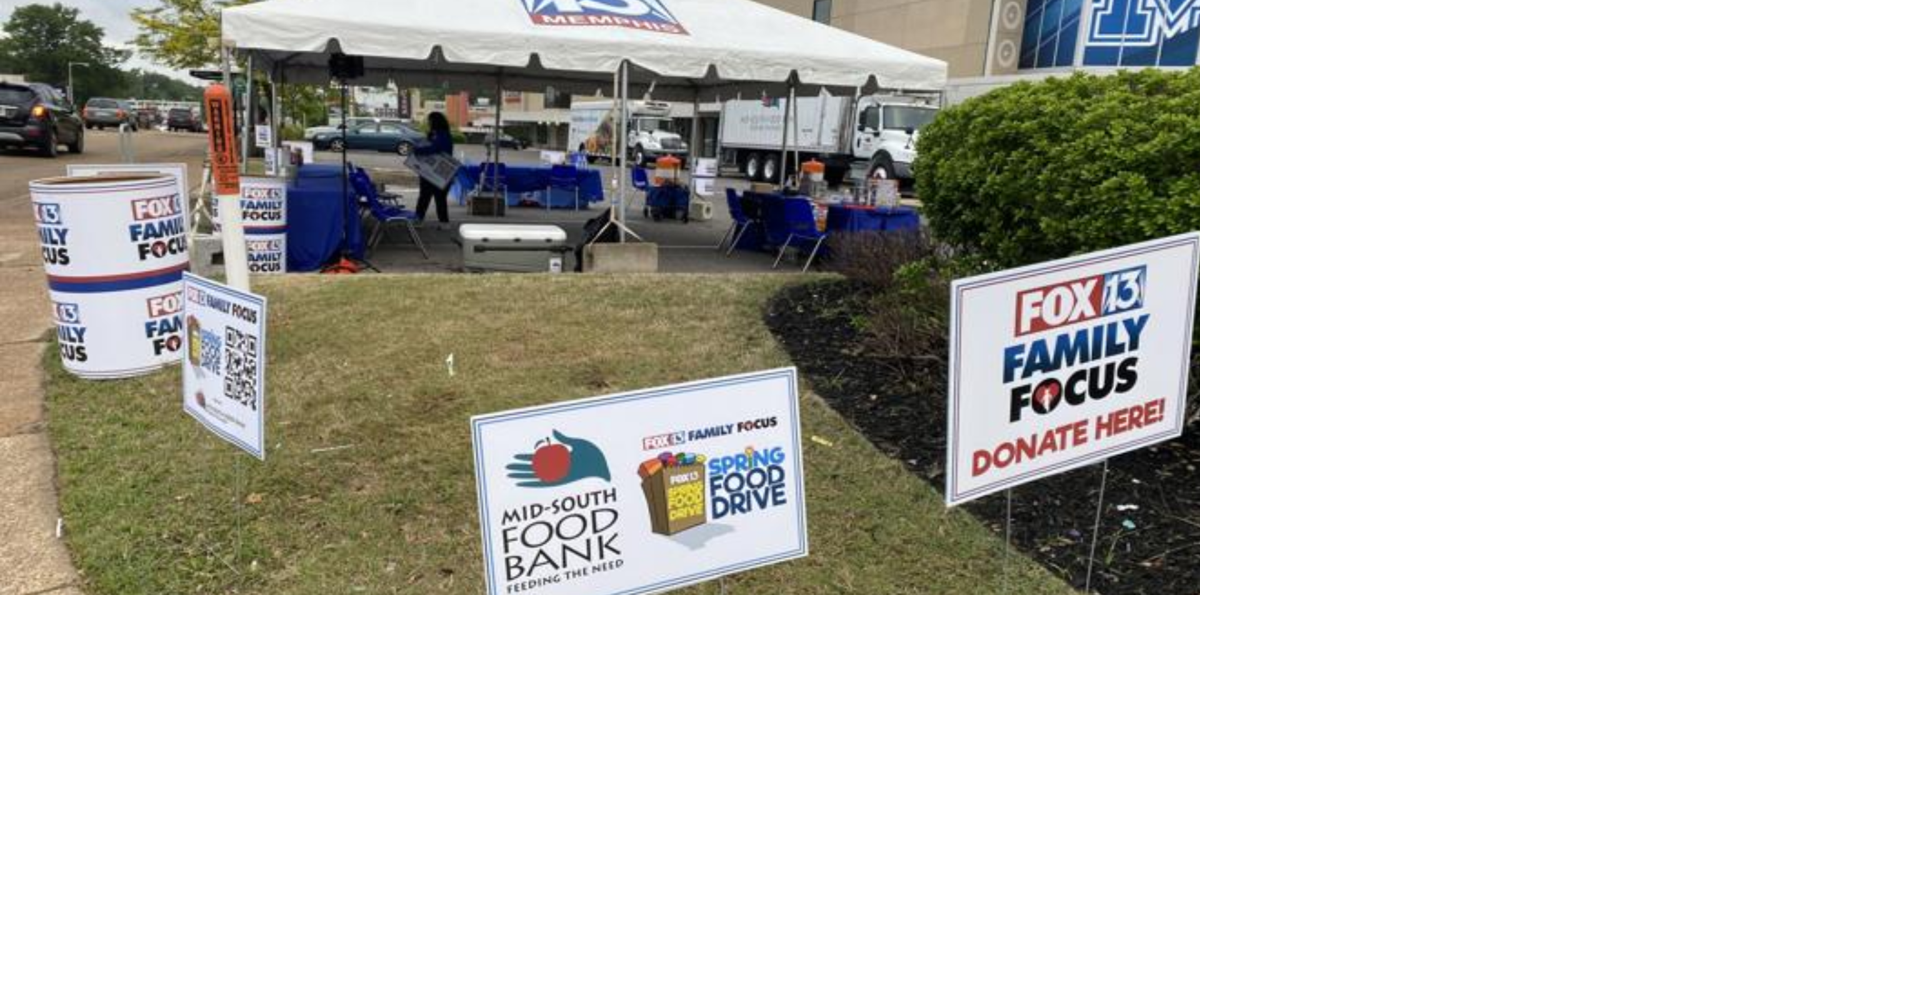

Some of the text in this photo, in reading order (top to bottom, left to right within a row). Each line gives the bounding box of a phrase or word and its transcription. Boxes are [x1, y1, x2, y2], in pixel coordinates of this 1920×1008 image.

[542, 15, 679, 33] MEMPHIS
[134, 197, 174, 219] FOX
[241, 200, 282, 211] FAMILY
[242, 211, 281, 221] FOCUS
[248, 252, 282, 262] AMILY
[249, 263, 281, 273] OCUS
[207, 293, 231, 314] FAMILY
[232, 303, 257, 325] FOCUS
[1020, 269, 1143, 333] FOX 13
[1003, 314, 1150, 384] FAMILY
[1010, 357, 1138, 423] FOCUS
[643, 437, 670, 450] FOX
[688, 424, 734, 441] FAMILY
[737, 416, 778, 433] FOCUS
[971, 398, 1165, 477] DONATE HERE!
[708, 446, 786, 476] SPRING
[669, 481, 704, 497] SPRING
[710, 464, 786, 497] FOOD
[502, 487, 617, 525] MID-SOUTH
[668, 492, 704, 509] FOOD
[669, 503, 704, 521] DRIVE
[712, 484, 787, 520] DRIVE
[502, 508, 618, 554] FOOD
[505, 533, 621, 582] BANK
[506, 559, 624, 594] FEEDING THE NEED
